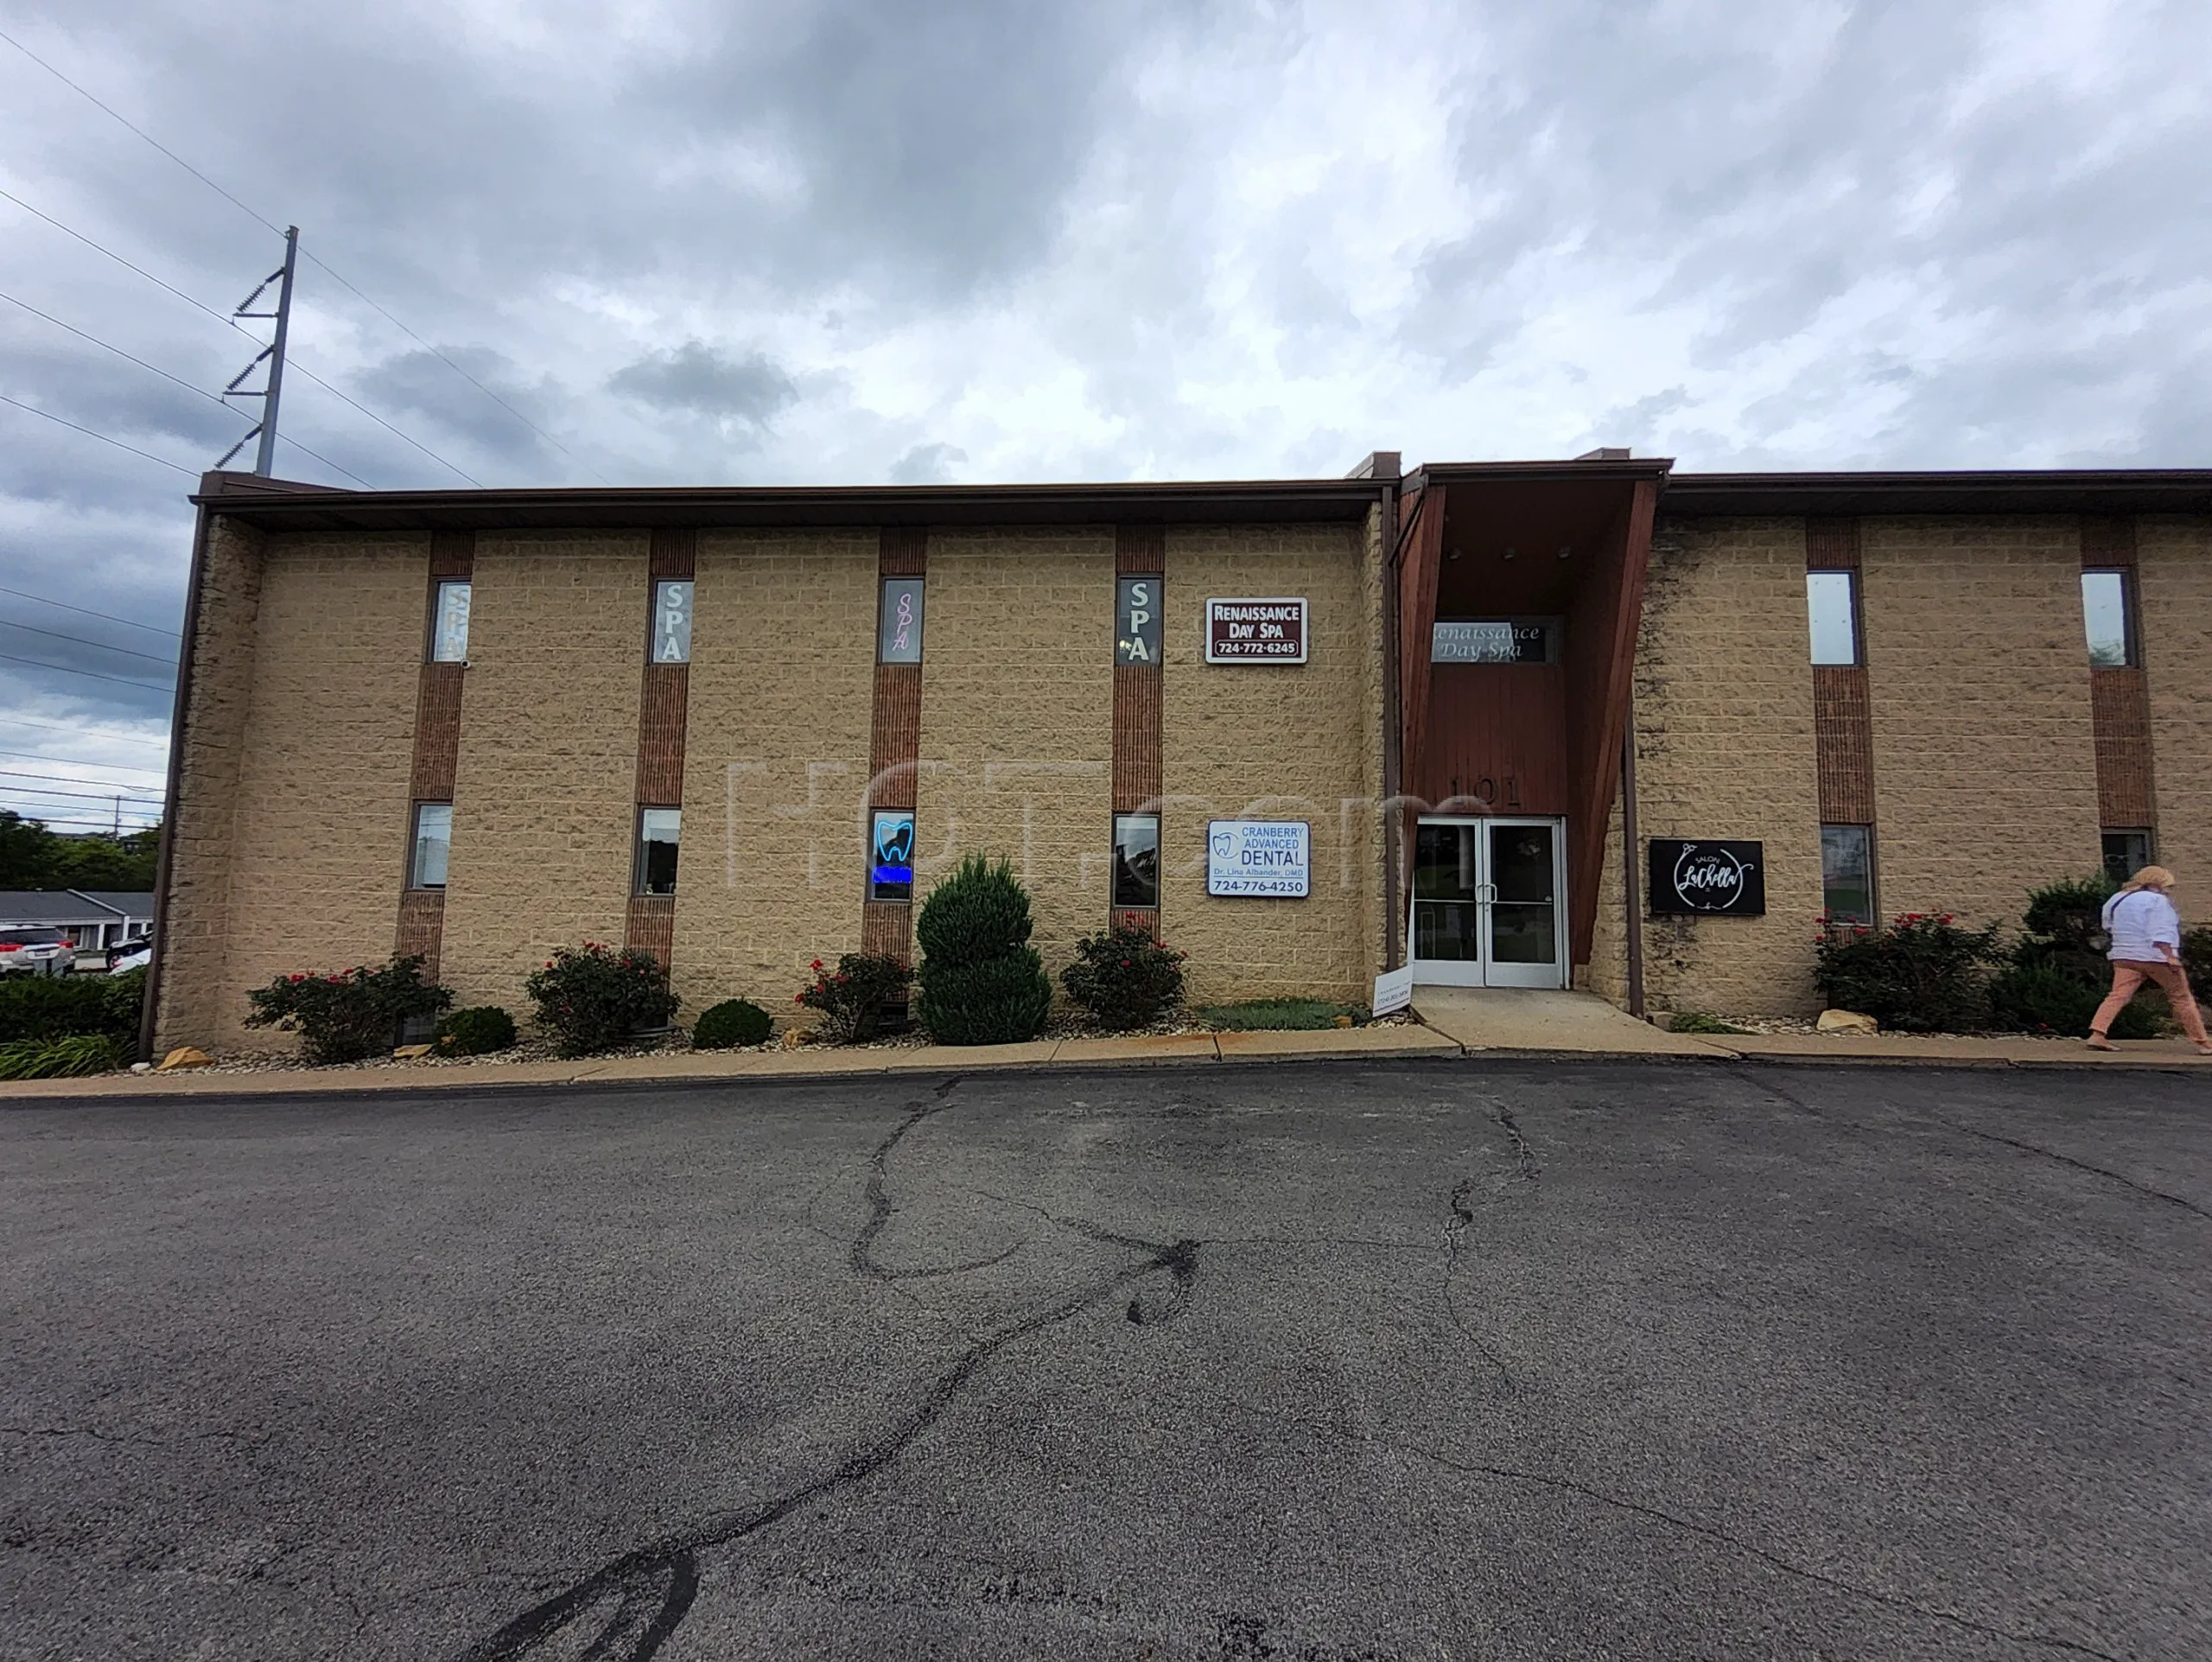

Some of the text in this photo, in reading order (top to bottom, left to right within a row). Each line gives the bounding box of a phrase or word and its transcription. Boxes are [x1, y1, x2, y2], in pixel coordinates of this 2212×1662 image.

[1128, 583, 1150, 660] SPA
[1214, 606, 1300, 621] RENAISSANCE
[661, 584, 684, 660] SPA
[892, 593, 913, 652] SPA
[1229, 622, 1284, 639] DAY SPA
[1441, 641, 1522, 662] Day Spa
[1450, 777, 1521, 806] 101
[1242, 827, 1304, 837] CRANBERRY
[1244, 838, 1300, 849] ADVANCED
[1242, 850, 1304, 866] DENTAL
[1695, 856, 1721, 864] SALON
[1214, 881, 1303, 892] 724-776-4250
